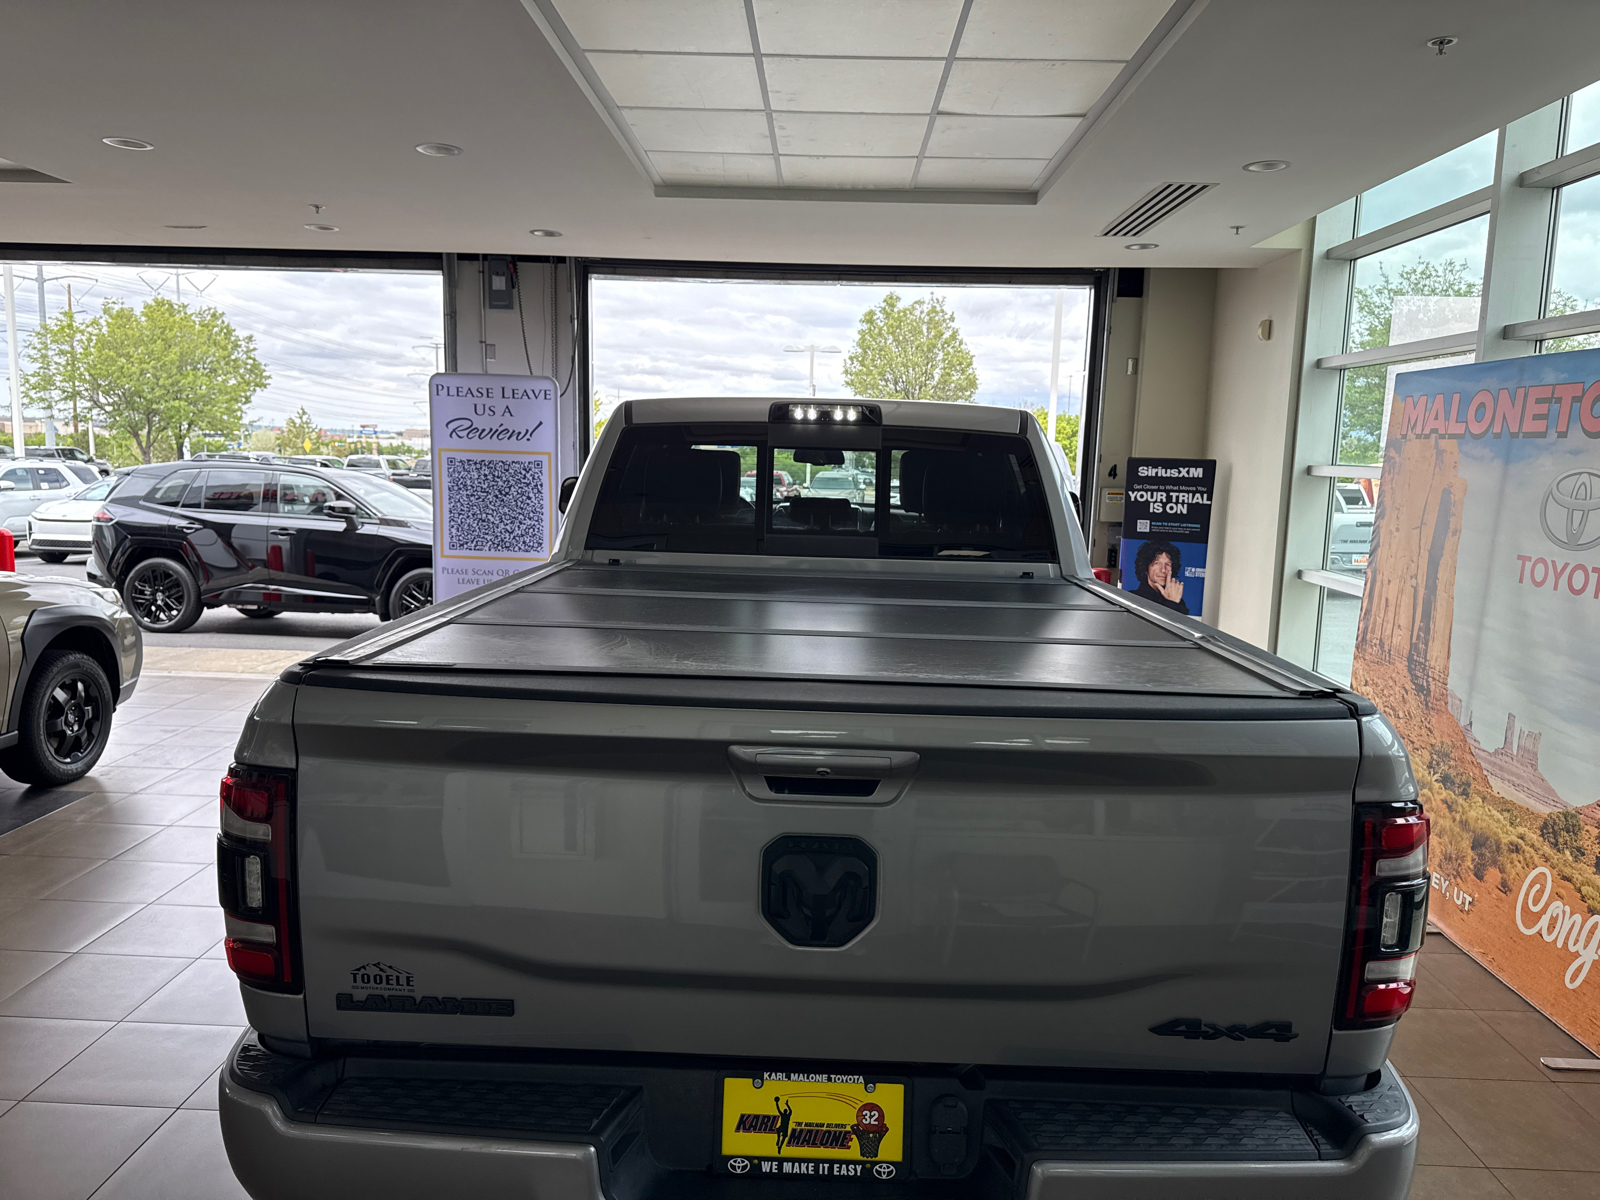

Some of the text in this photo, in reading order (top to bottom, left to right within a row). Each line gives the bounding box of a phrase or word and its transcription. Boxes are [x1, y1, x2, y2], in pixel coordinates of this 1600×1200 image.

[435, 384, 552, 400] PLEASE LEAVE
[473, 403, 514, 417] US A
[445, 417, 543, 441] Review!
[1108, 464, 1118, 480] 4
[1138, 466, 1203, 478] SiriusXM
[1128, 491, 1166, 502] YOUR
[1170, 492, 1211, 504] TRIAL
[1150, 503, 1187, 514] IS ON
[441, 567, 468, 575] PLEASE
[472, 568, 494, 576] SCAN
[496, 569, 509, 577] QR
[1428, 868, 1472, 911] EY, UT
[1516, 866, 1600, 989] Cong
[350, 972, 414, 987] TOOELE
[336, 993, 515, 1017] LARAMIE
[764, 1072, 864, 1084] KARL MALONE TOYOTA
[734, 1113, 780, 1134] KARL
[862, 1110, 878, 1125] 32
[786, 1128, 853, 1149] MALONE
[761, 1161, 862, 1176] WE MAKE IT EASY
